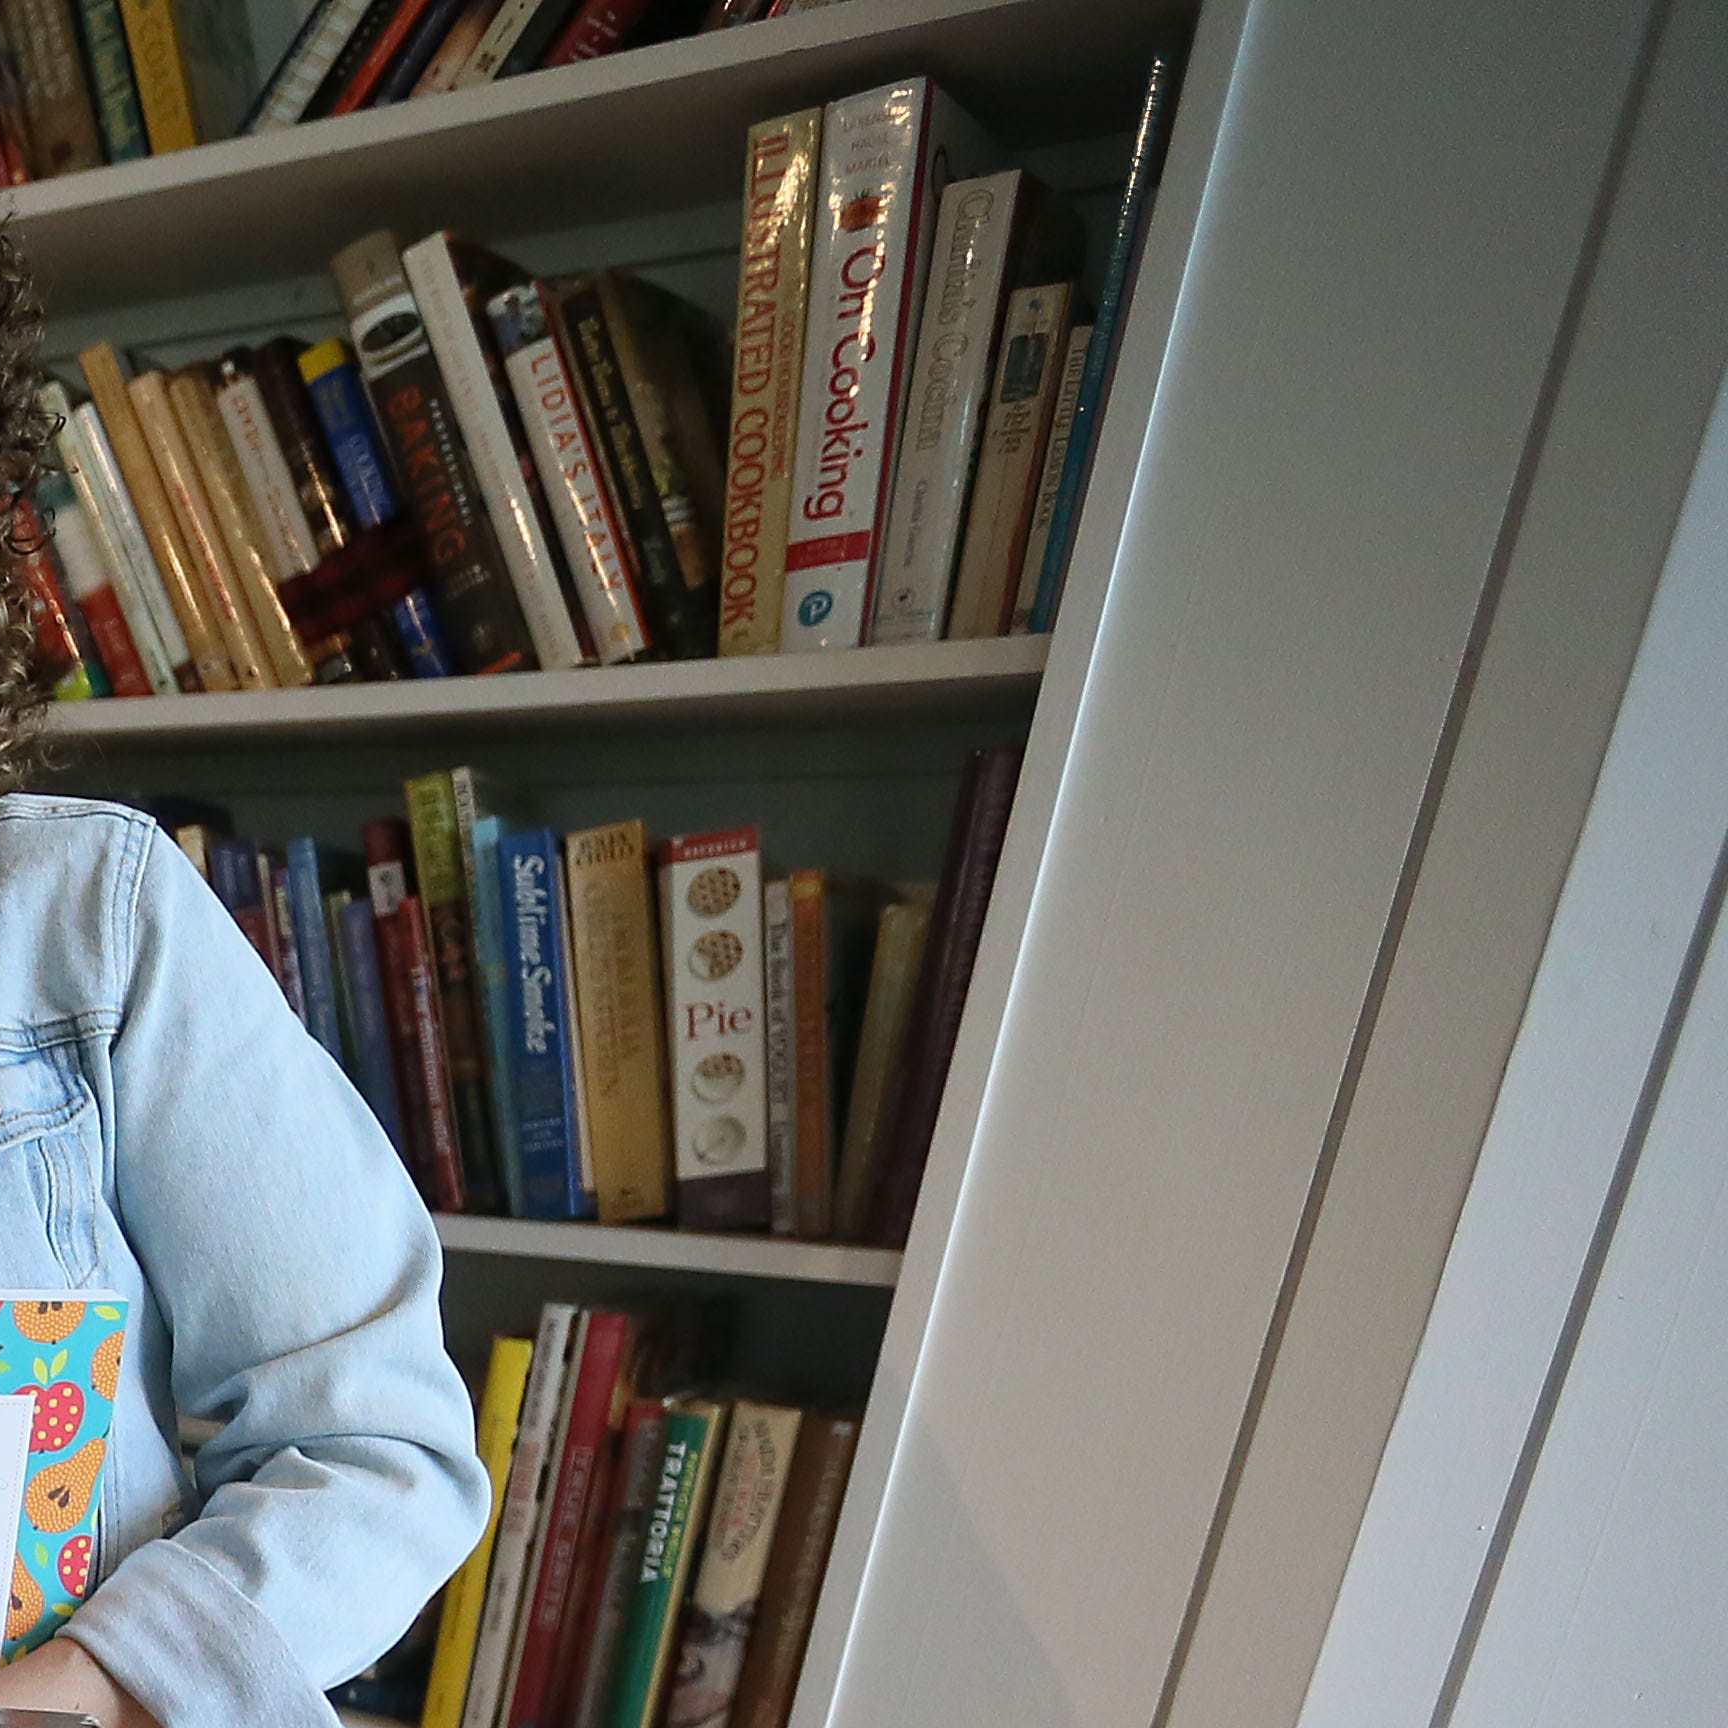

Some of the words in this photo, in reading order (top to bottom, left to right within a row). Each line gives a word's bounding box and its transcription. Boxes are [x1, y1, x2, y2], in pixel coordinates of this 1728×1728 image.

[839, 244, 885, 320] On
[530, 351, 589, 480] LIDIA'S
[573, 490, 624, 591] ITALY
[802, 334, 877, 521] Cooking
[916, 335, 971, 450] Cocina
[388, 385, 469, 563] BAKING
[721, 407, 770, 627] COOKBOOK
[684, 1001, 753, 1042] Pie
[641, 1440, 686, 1583] TRATTORIA
